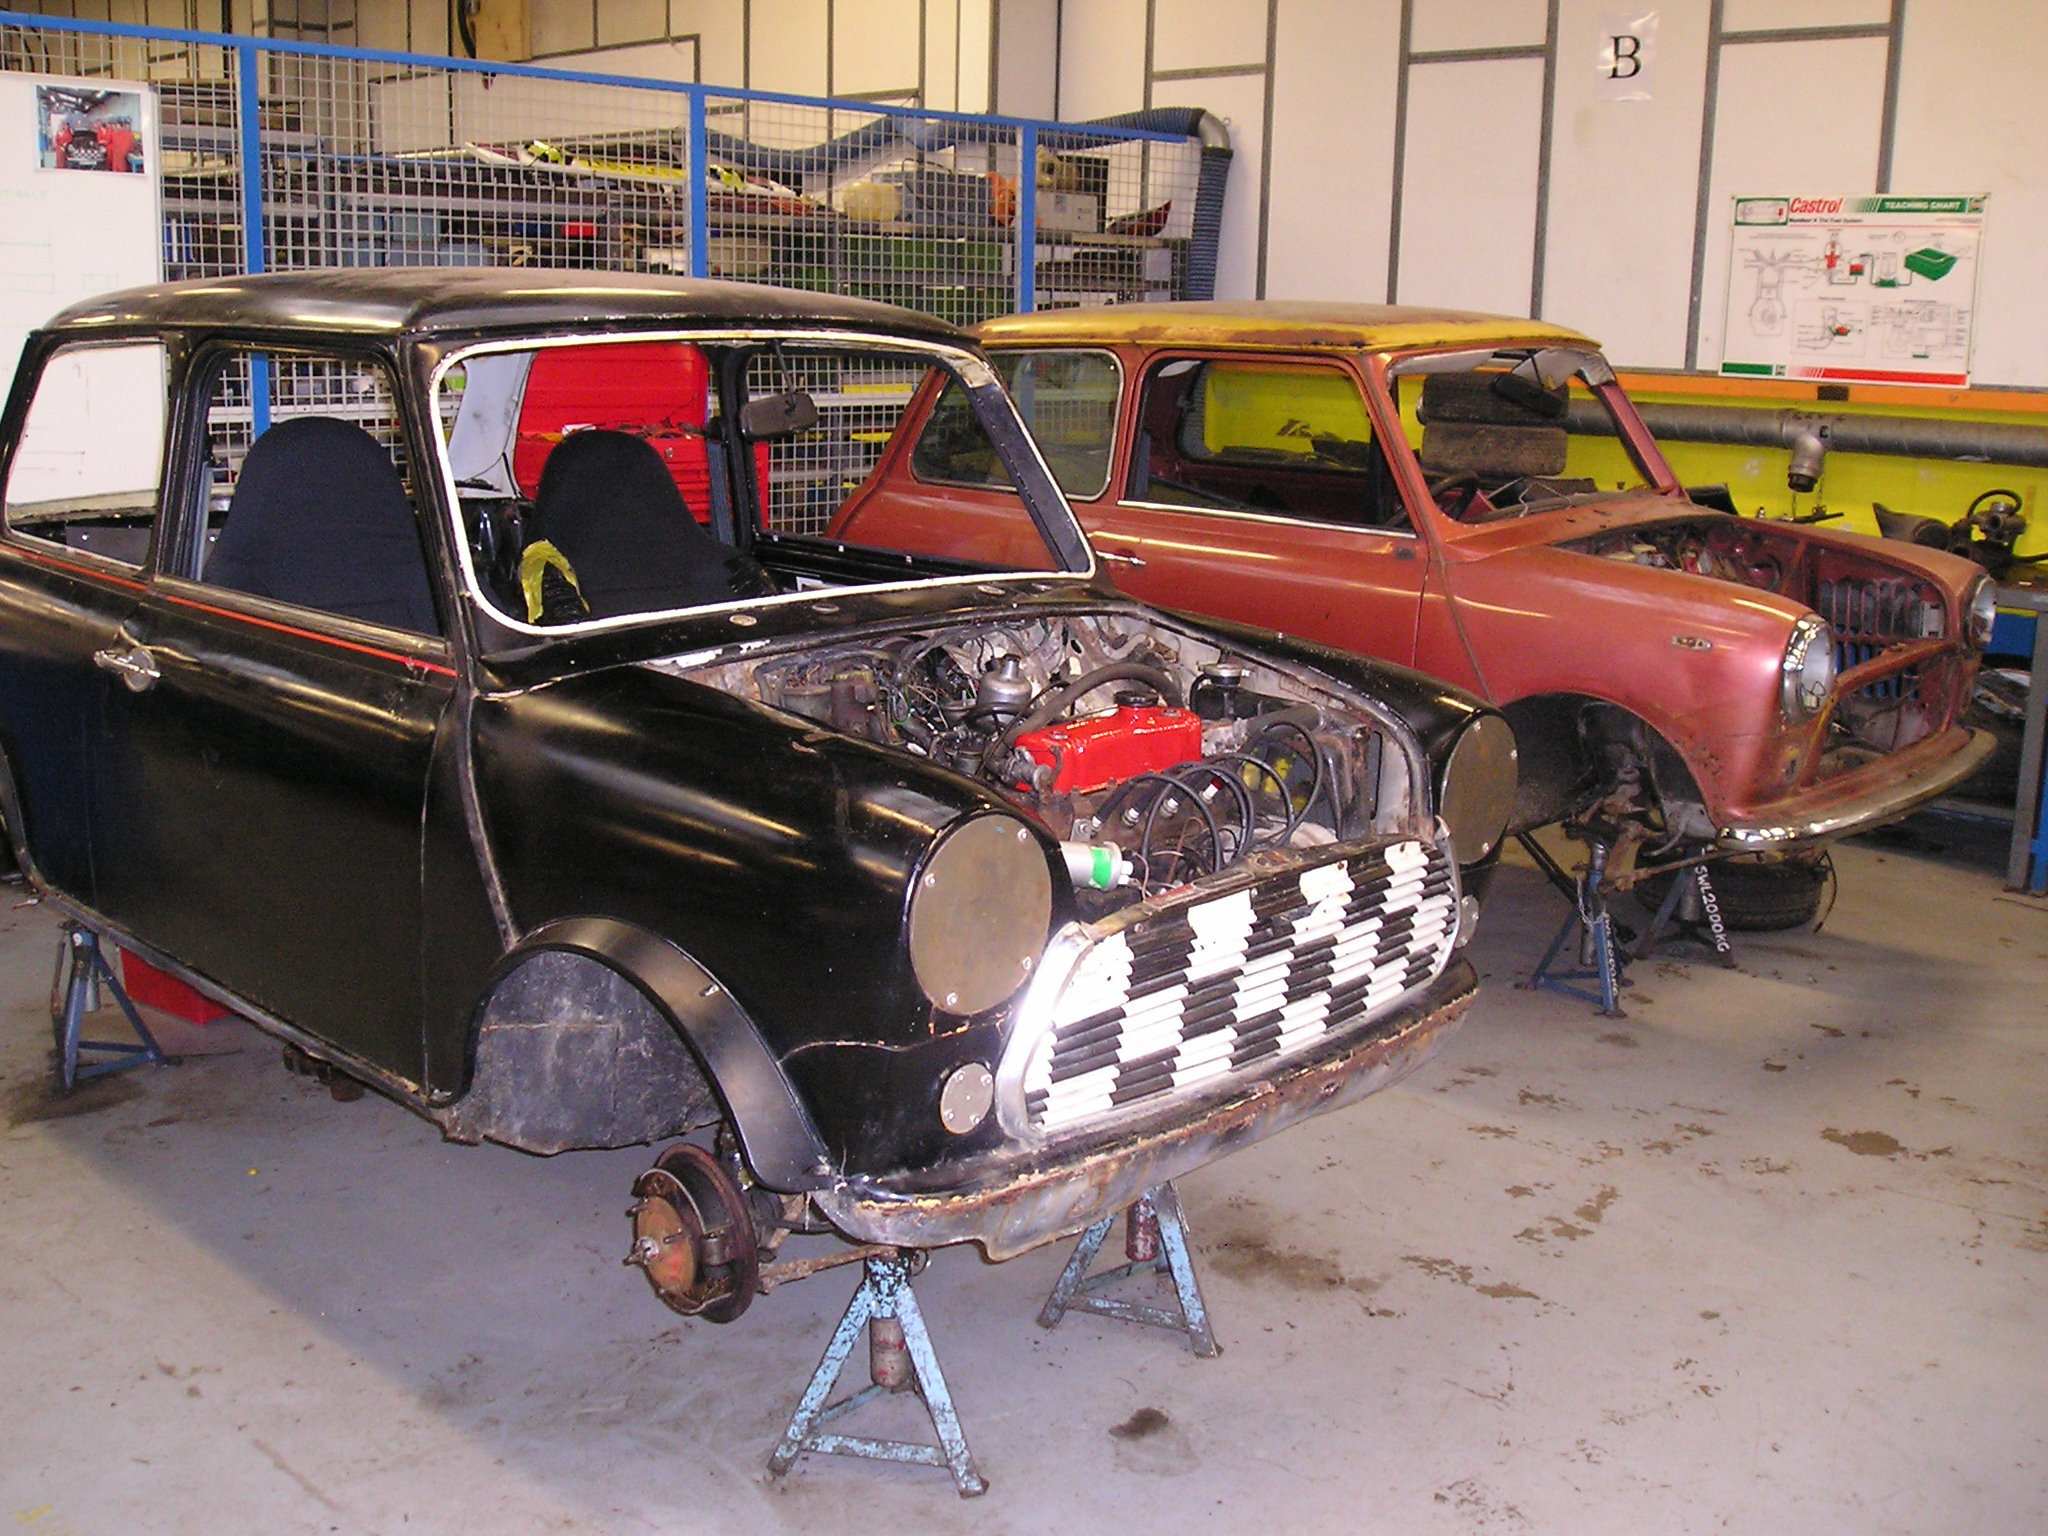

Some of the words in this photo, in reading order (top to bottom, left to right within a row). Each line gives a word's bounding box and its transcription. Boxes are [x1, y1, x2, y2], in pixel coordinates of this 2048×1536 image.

[1606, 34, 1642, 79] B
[1790, 197, 1843, 214] Castrol
[1884, 201, 1928, 210] TEACHING
[1929, 201, 1961, 211] CHART
